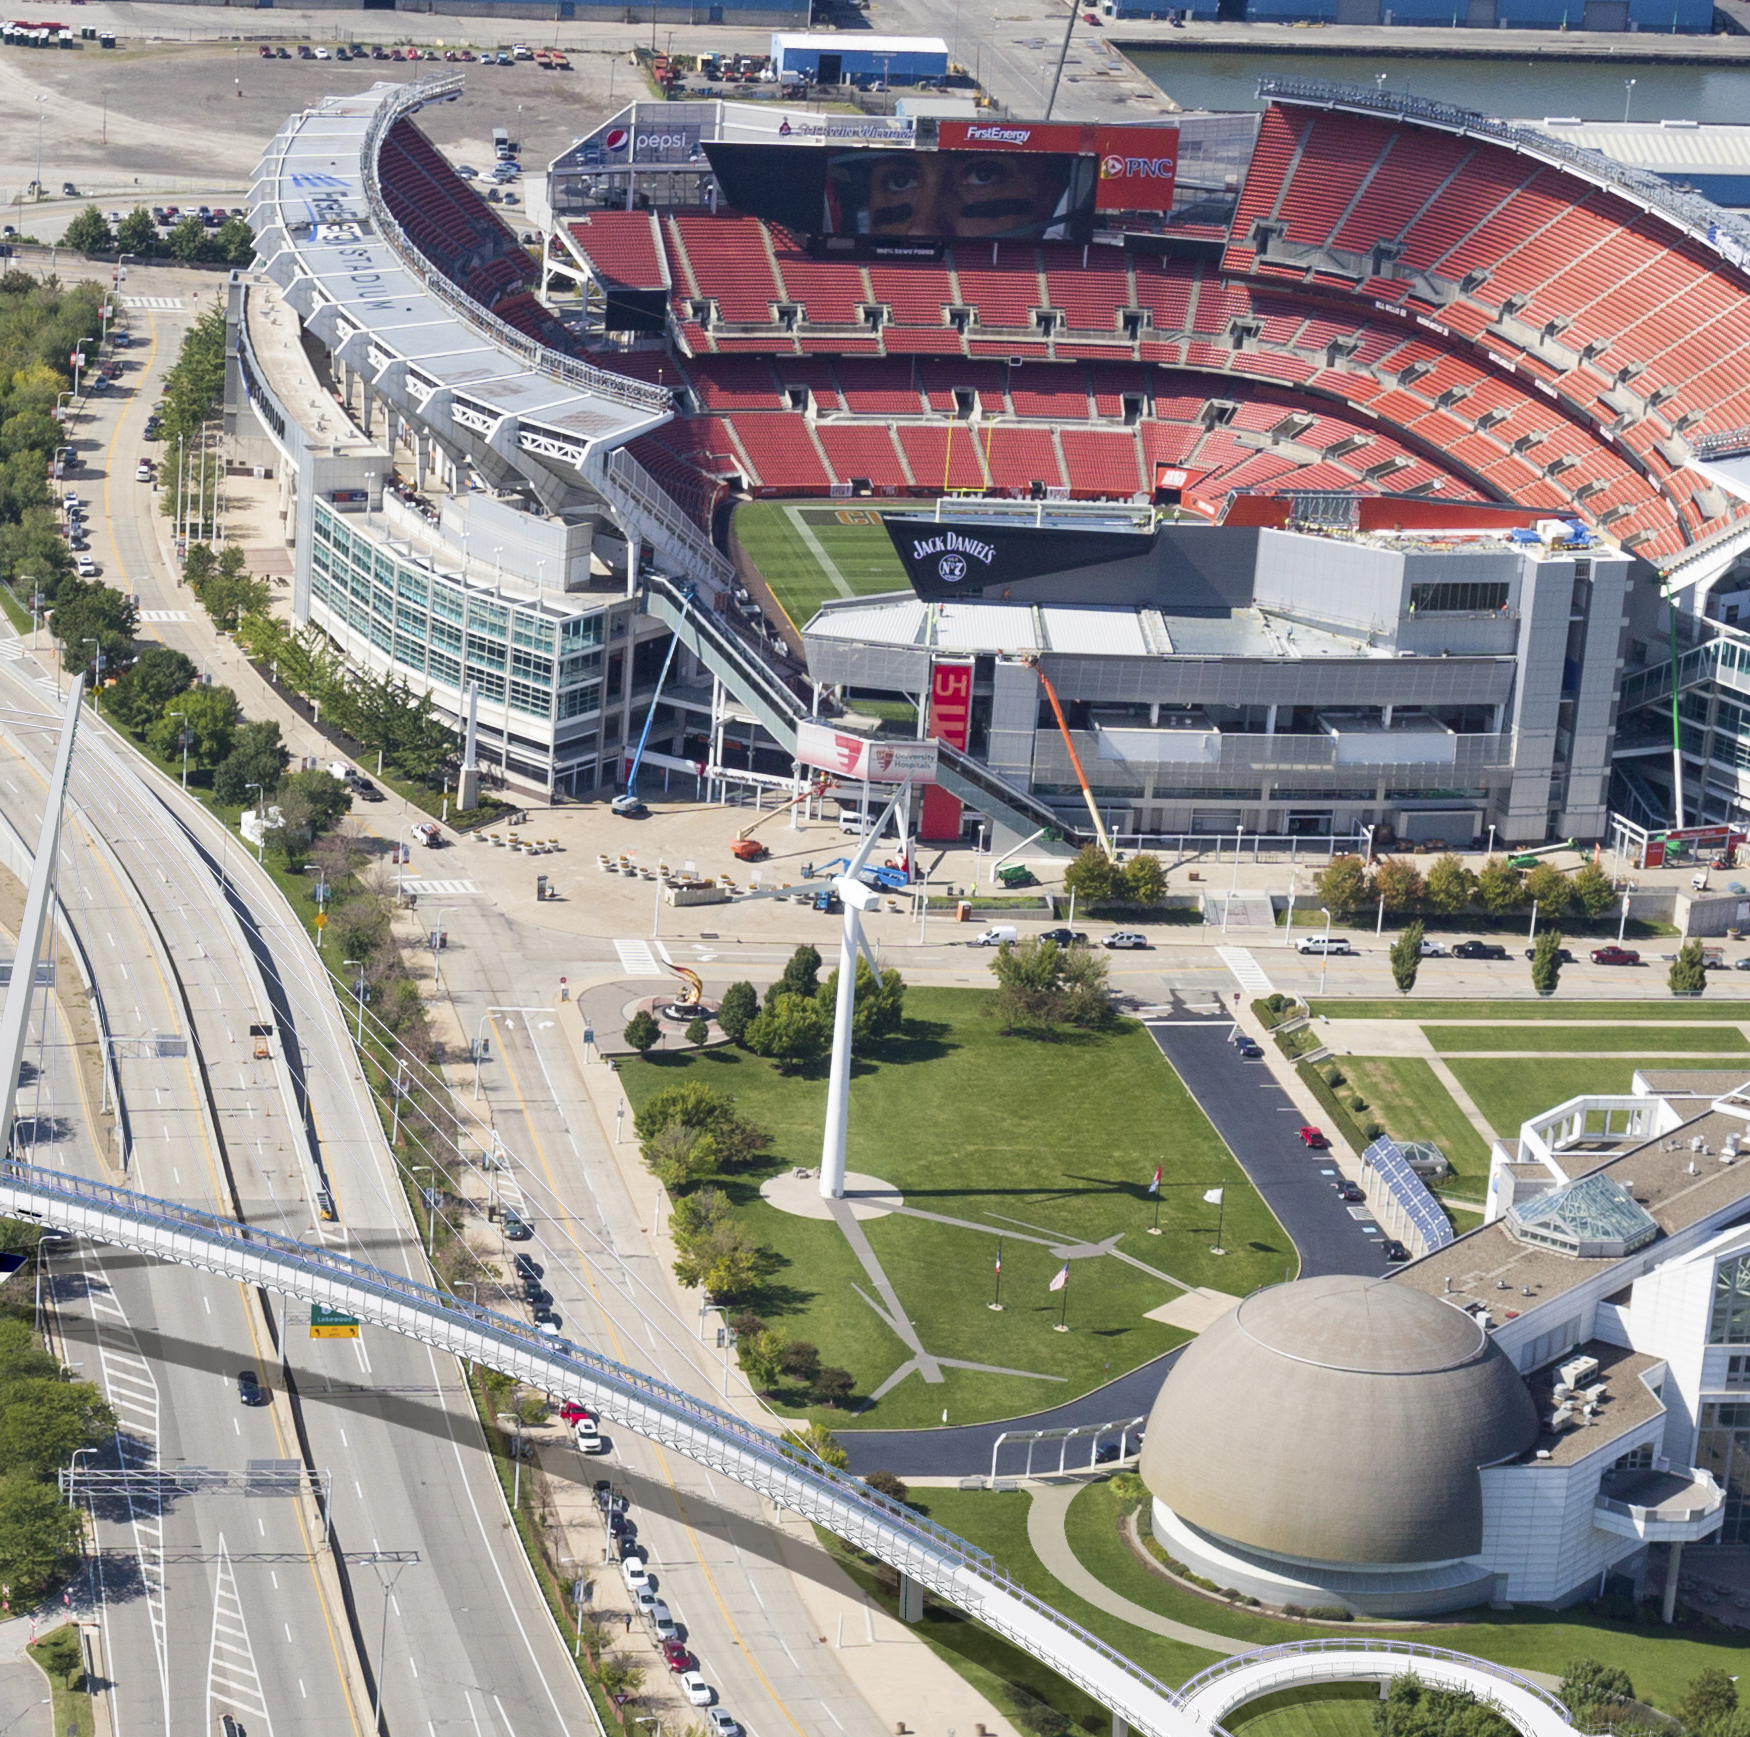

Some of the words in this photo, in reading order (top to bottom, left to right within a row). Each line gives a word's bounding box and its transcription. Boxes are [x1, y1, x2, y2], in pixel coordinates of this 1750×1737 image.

[636, 132, 687, 151] pepsi
[967, 126, 1031, 142] FirstEnergy
[1125, 157, 1173, 178] PNC
[339, 248, 396, 311] STADIUM
[913, 536, 945, 559] JACK
[947, 531, 996, 564] DANIEL'S
[936, 673, 968, 697] UH
[894, 761, 931, 769] Hospitals
[895, 753, 936, 762] University
